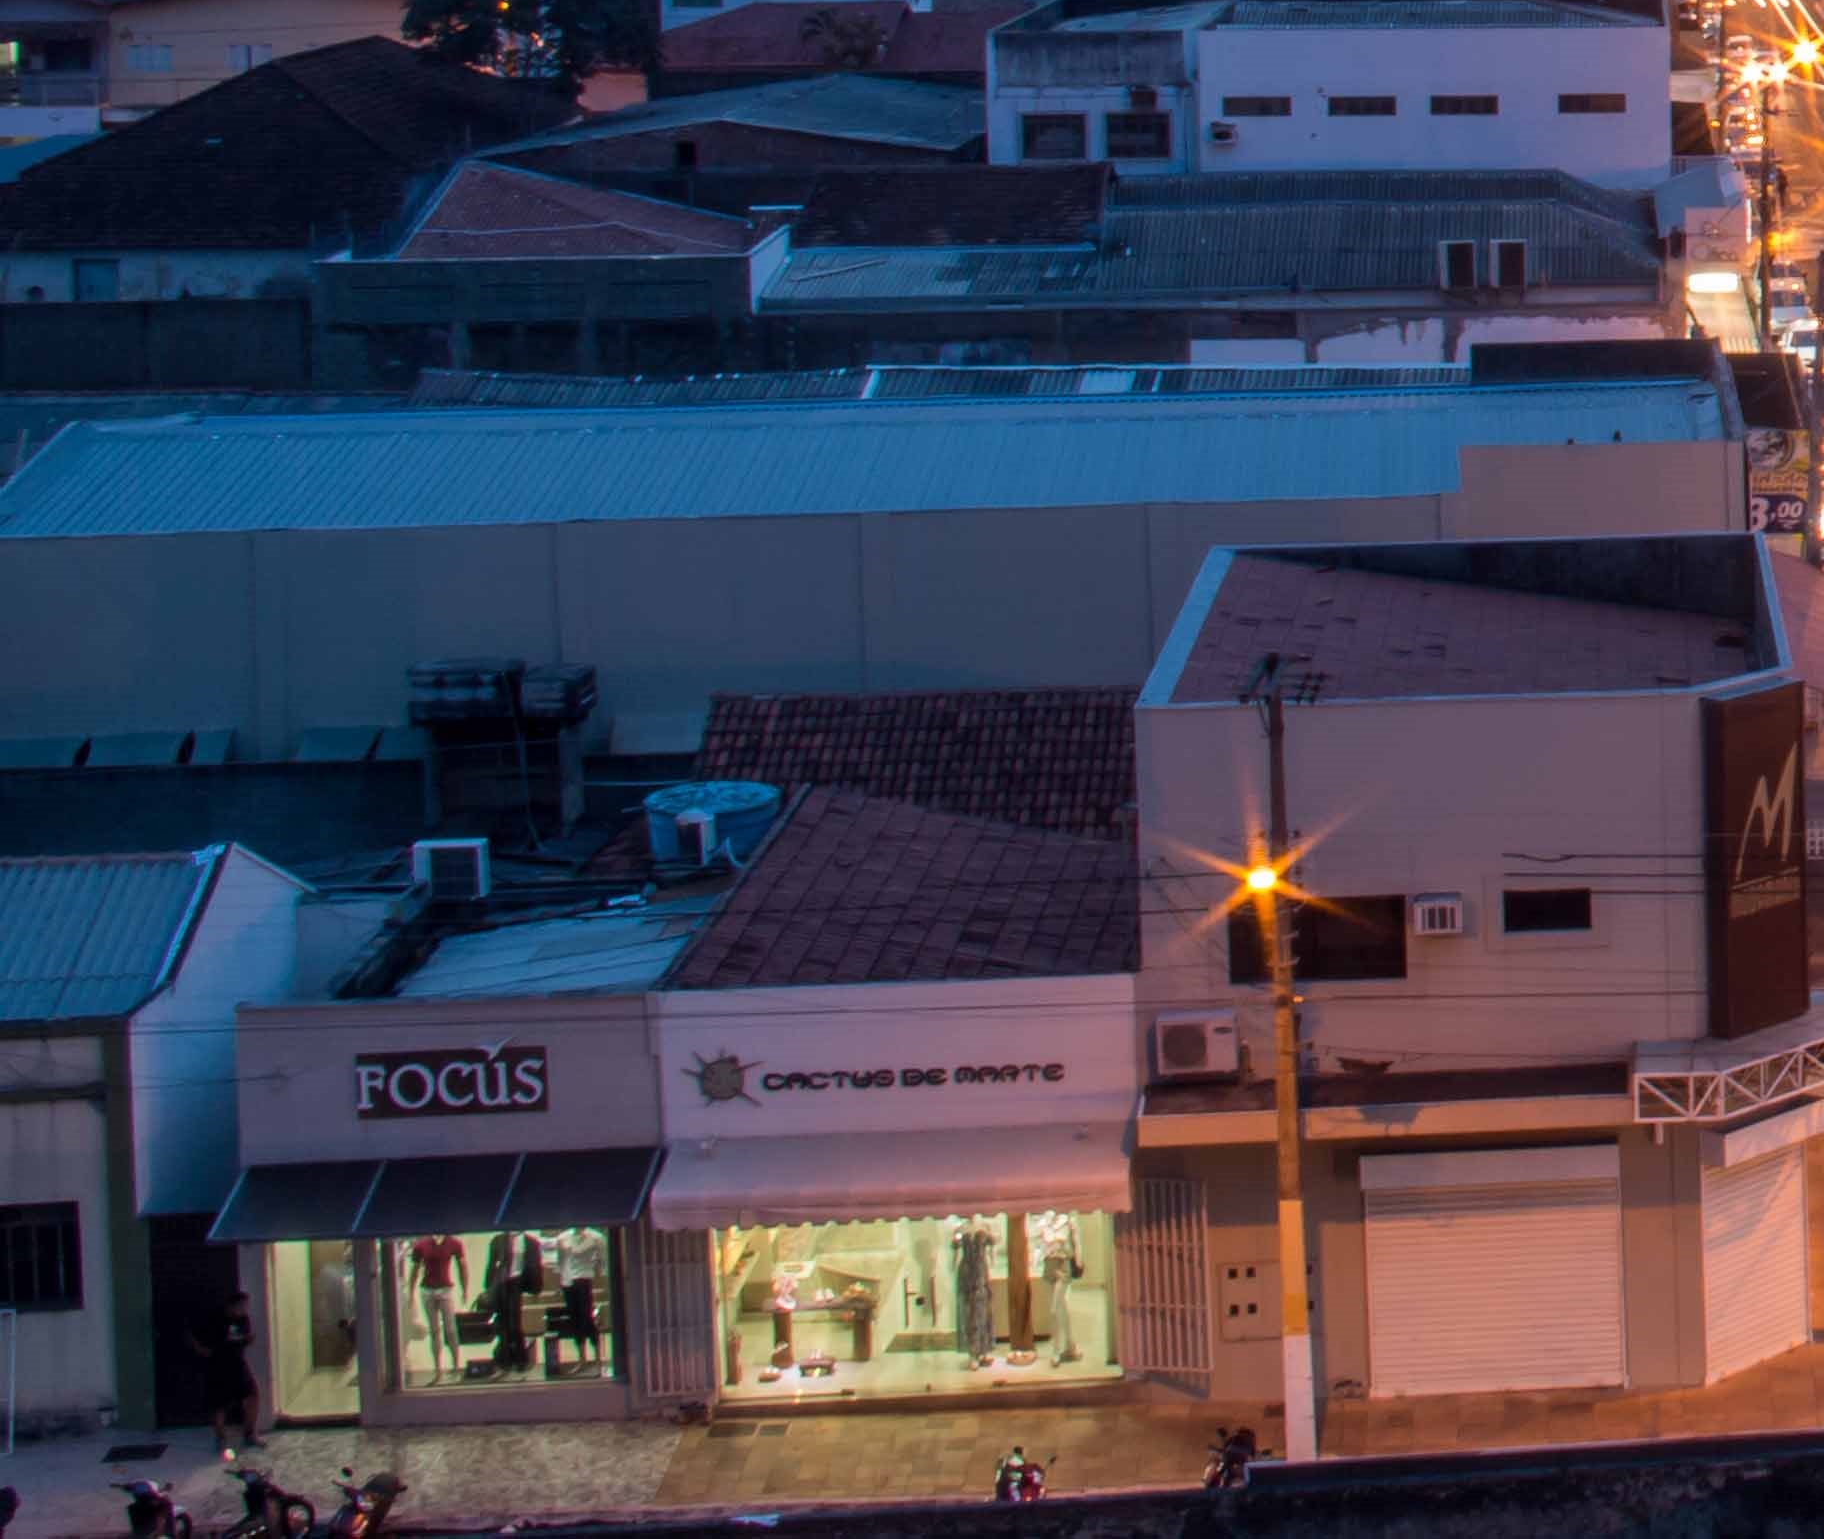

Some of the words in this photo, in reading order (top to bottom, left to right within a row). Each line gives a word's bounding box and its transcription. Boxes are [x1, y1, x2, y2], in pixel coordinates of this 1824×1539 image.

[761, 1069, 895, 1092] CACTUS
[901, 1066, 948, 1088] DE
[954, 1063, 1065, 1084] MARTE
